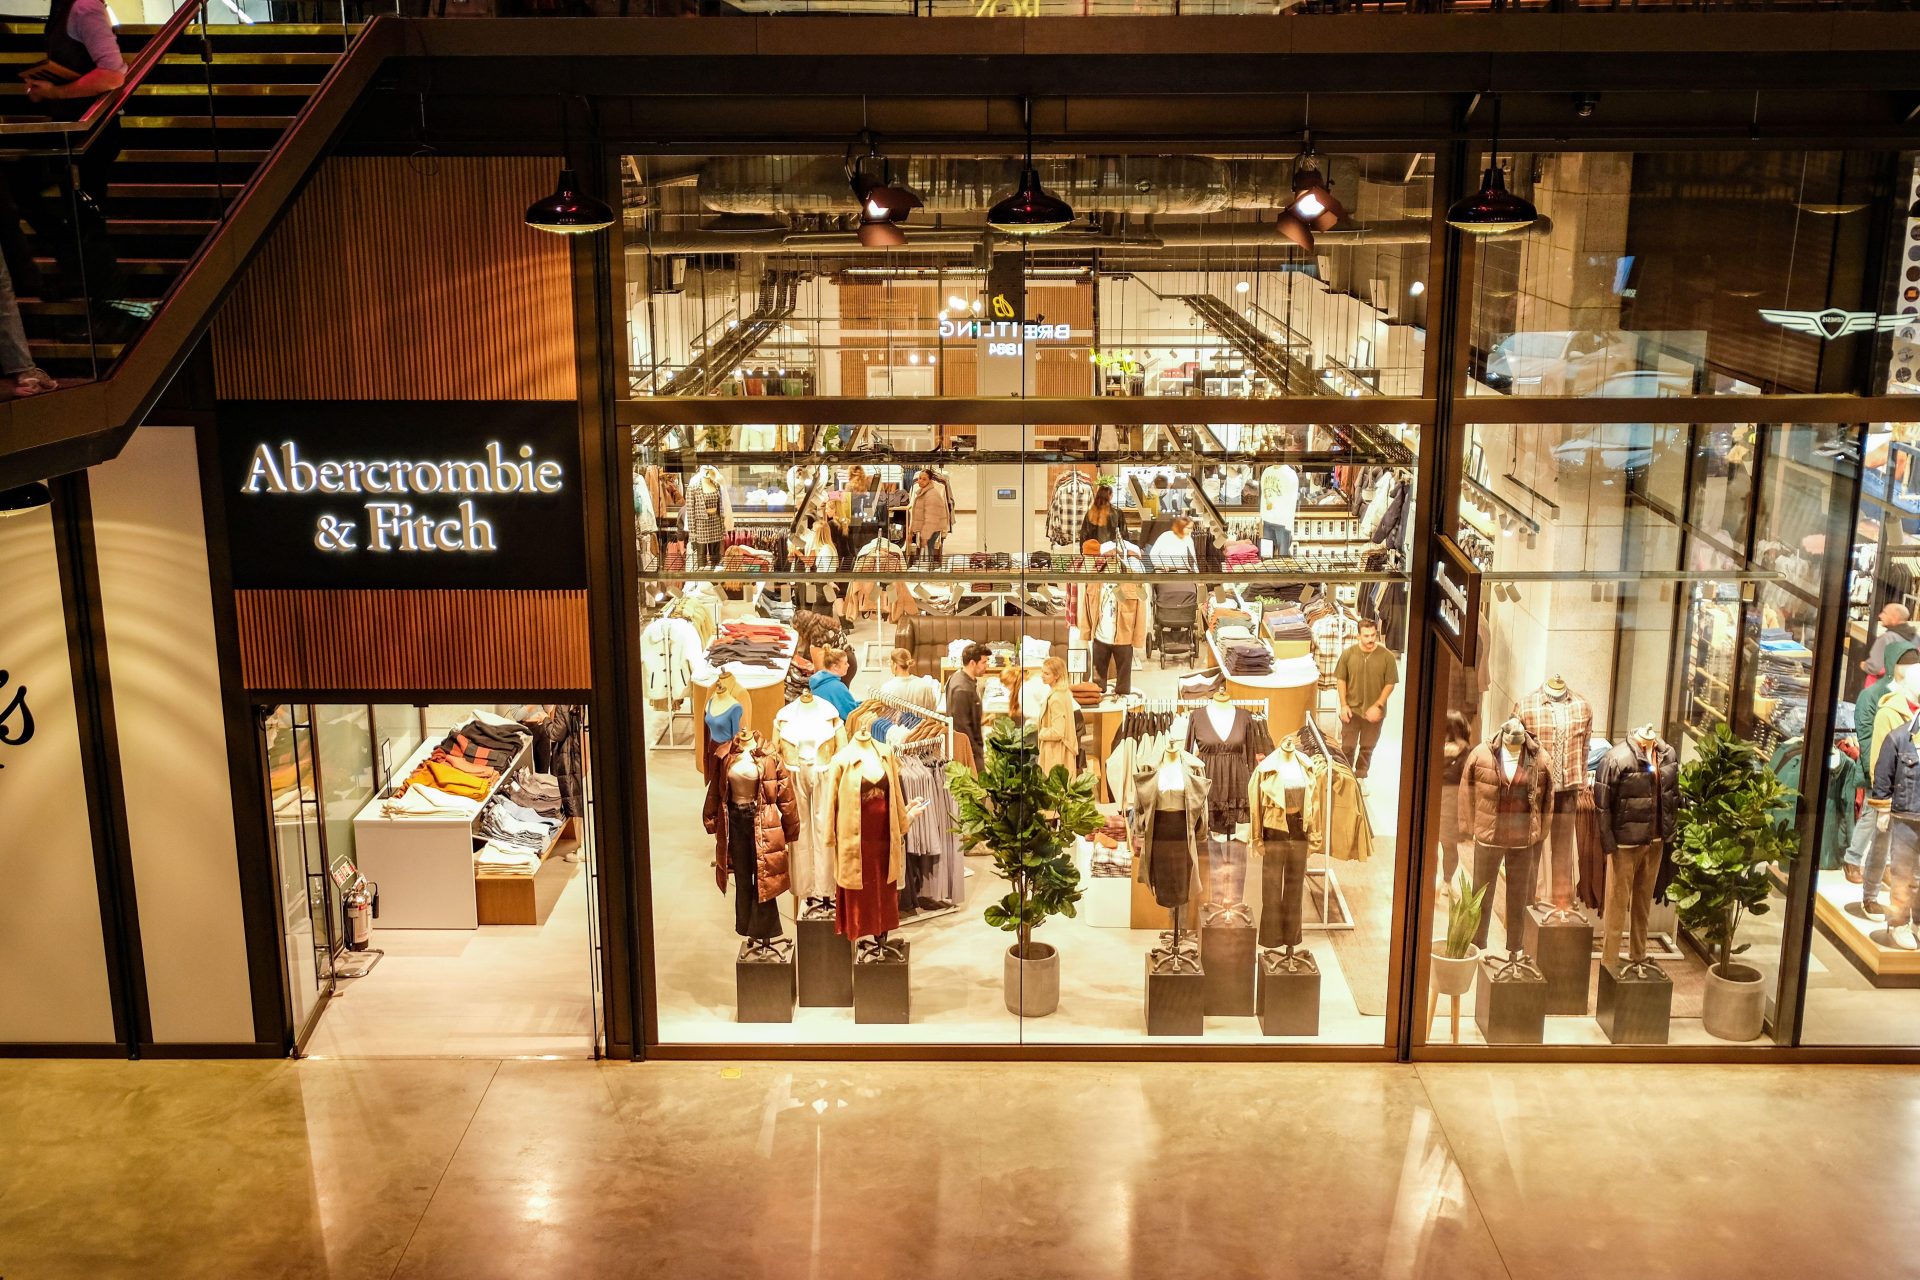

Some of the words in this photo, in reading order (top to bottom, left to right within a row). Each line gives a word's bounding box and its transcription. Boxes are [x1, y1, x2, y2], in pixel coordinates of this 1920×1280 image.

[240, 441, 562, 493] Abercrombie
[314, 515, 357, 551] &
[364, 500, 497, 551] Fitch
